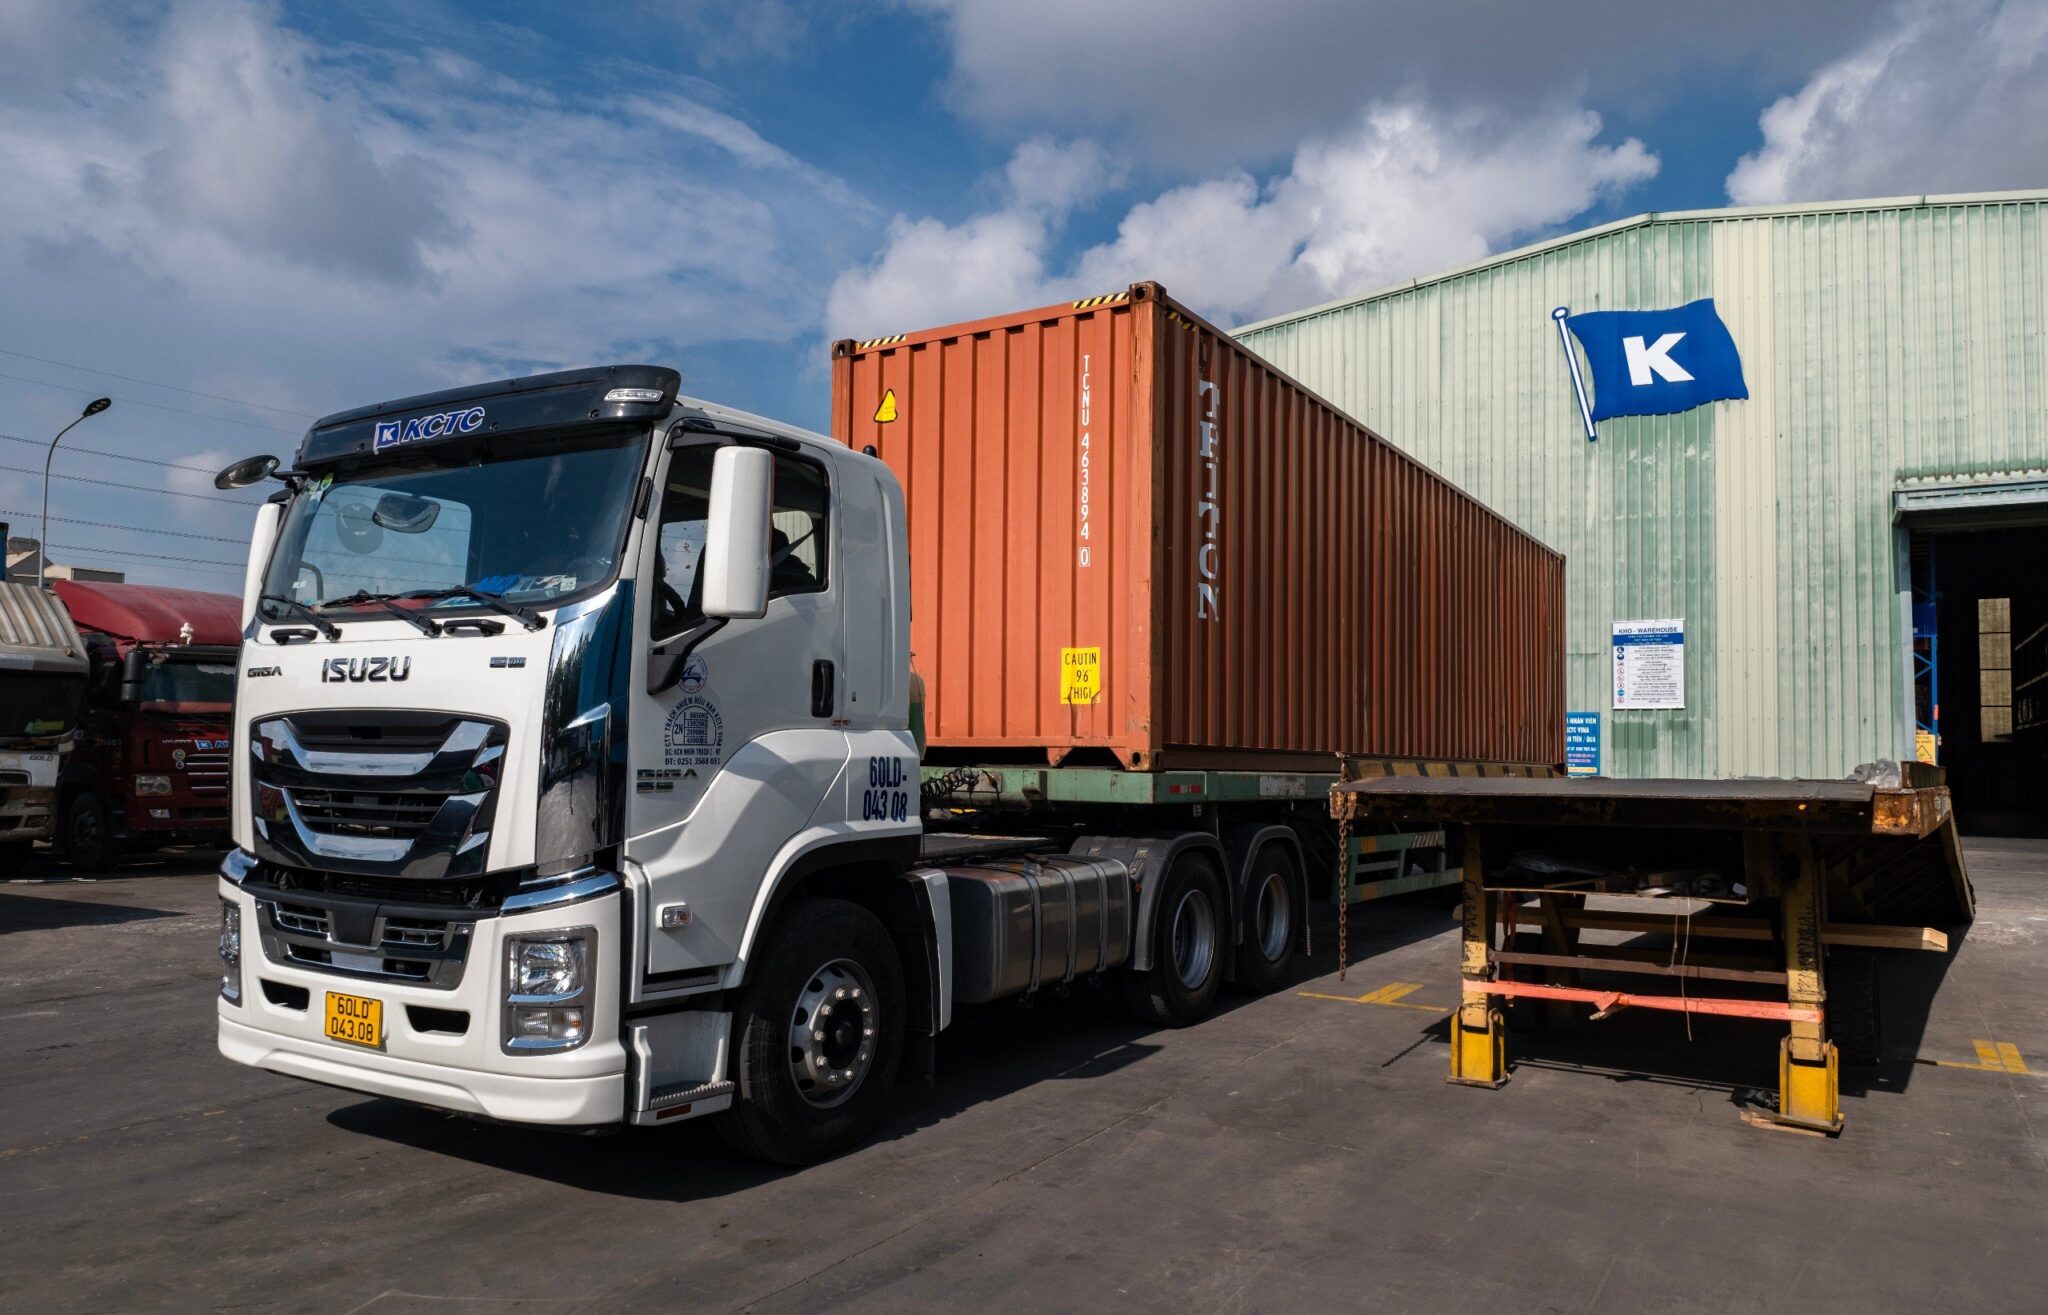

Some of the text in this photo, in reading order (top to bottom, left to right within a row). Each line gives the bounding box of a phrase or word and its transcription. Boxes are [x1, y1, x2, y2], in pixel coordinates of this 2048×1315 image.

[1623, 332, 1695, 386] K
[401, 406, 486, 443] KCTC
[1080, 354, 1090, 565] TCNU 463894 0
[248, 666, 283, 678] GIGA
[321, 656, 411, 683] ISUZU
[869, 756, 907, 788] 60LD-
[863, 789, 908, 823] 043 08
[337, 996, 369, 1019] 60LD
[331, 1016, 374, 1042] 043.08
